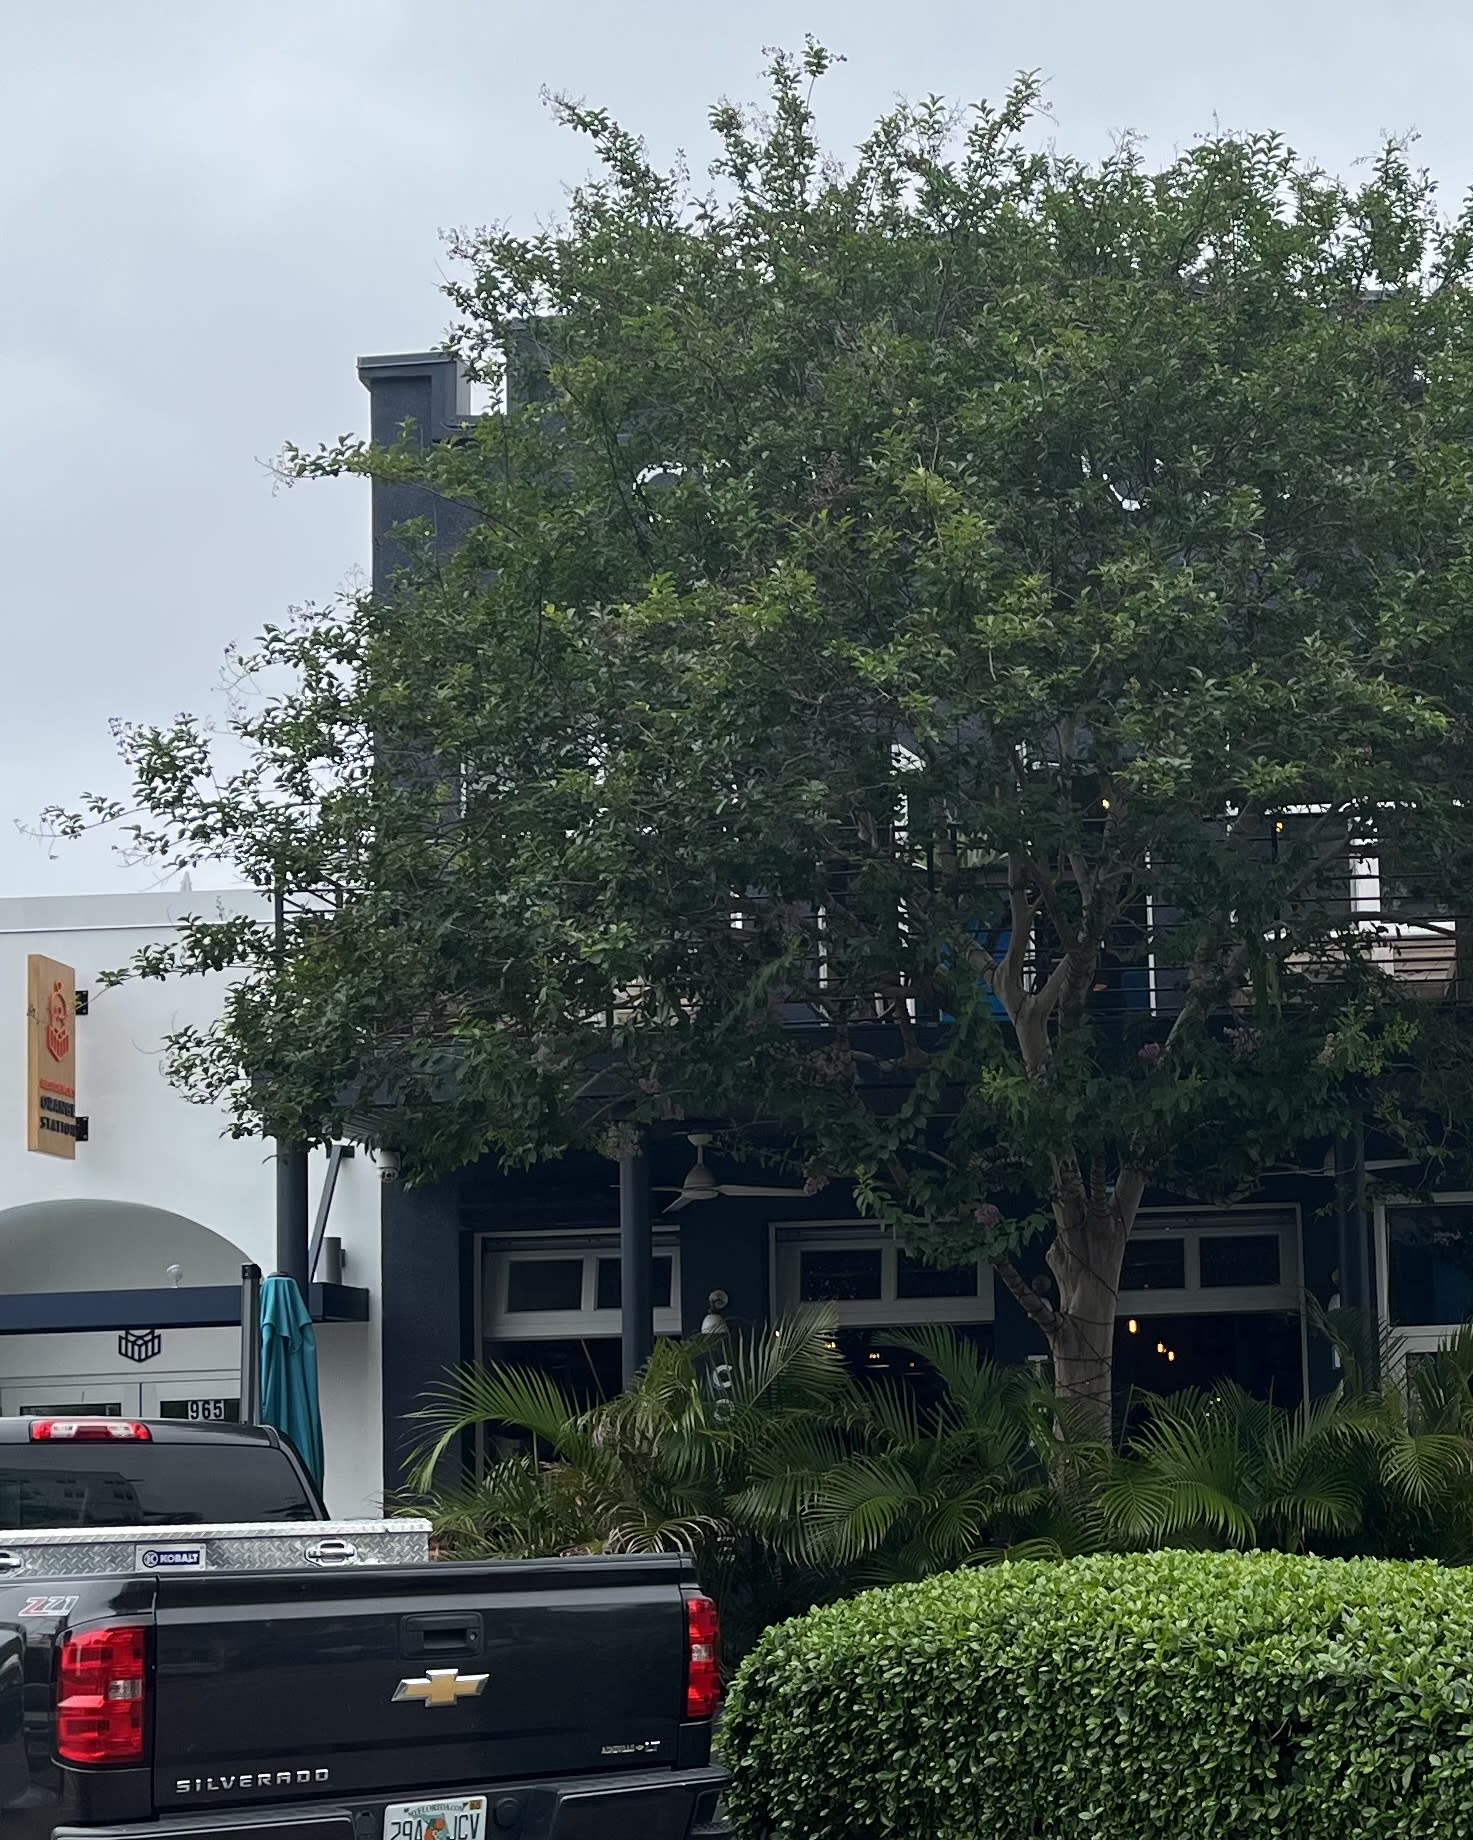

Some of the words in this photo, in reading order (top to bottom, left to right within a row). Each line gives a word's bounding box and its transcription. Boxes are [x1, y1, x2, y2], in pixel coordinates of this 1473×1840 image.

[190, 1400, 223, 1420] 965
[160, 1553, 199, 1564] KOBALT
[18, 1594, 80, 1617] Z71
[175, 1768, 330, 1793] SILVERADO
